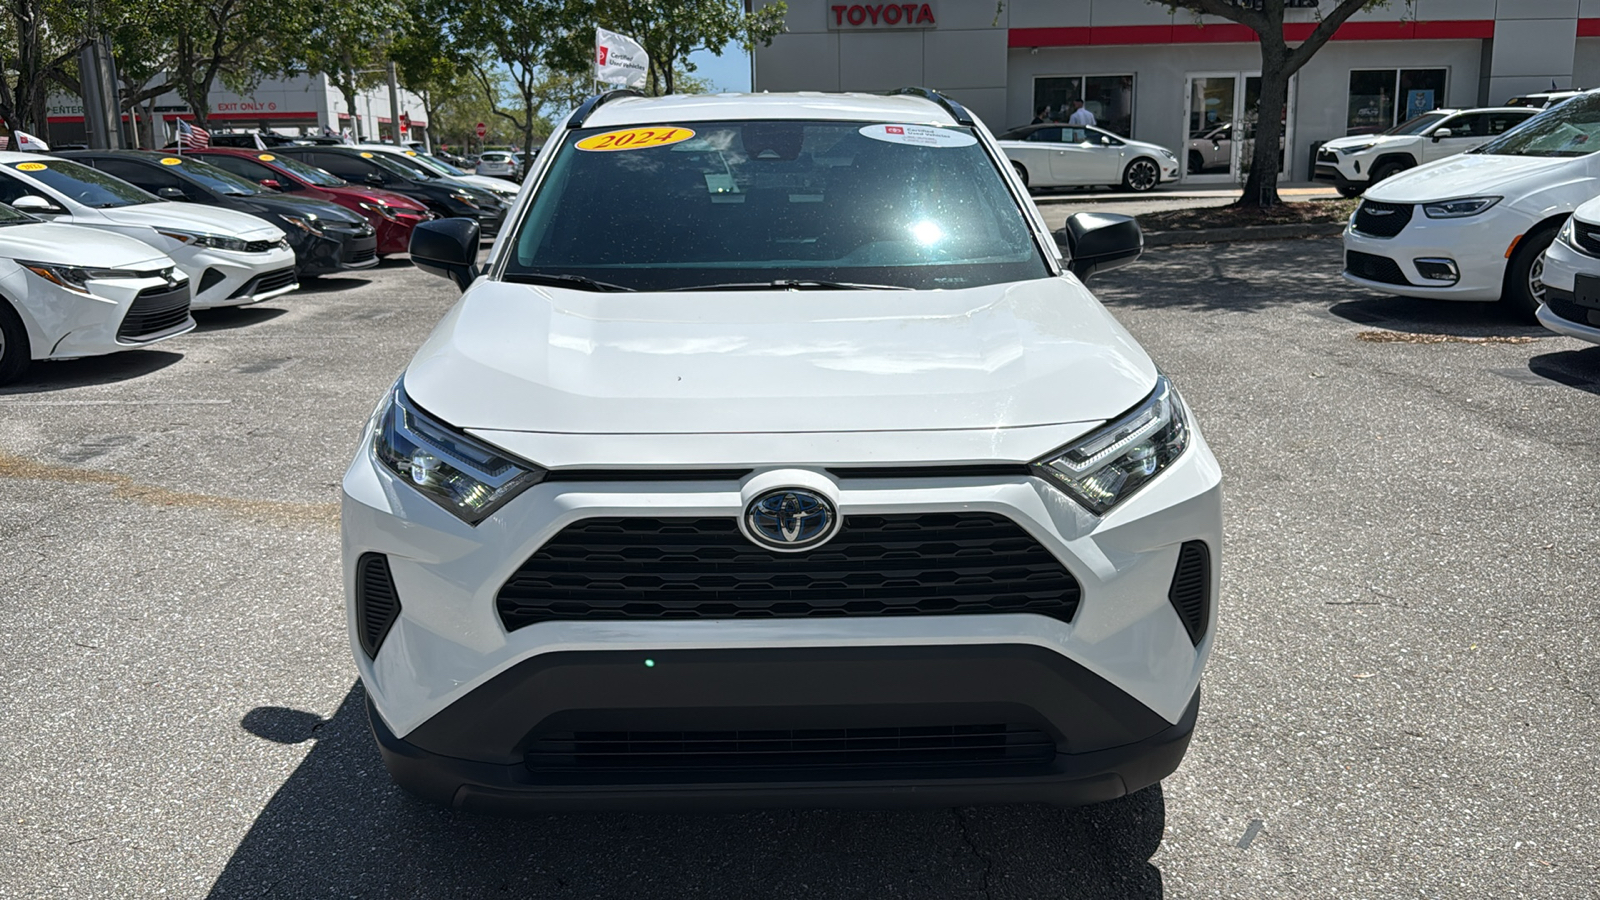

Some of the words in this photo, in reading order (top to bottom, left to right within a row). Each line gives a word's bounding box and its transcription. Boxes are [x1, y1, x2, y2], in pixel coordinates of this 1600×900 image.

[831, 3, 936, 26] TOYOTA
[610, 51, 634, 62] Certified
[609, 59, 623, 67] Used
[622, 61, 646, 71] Vehicles
[52, 105, 85, 115] ENTER
[217, 102, 237, 111] EXIT
[240, 102, 265, 111] ONLY
[593, 129, 679, 150] 2024
